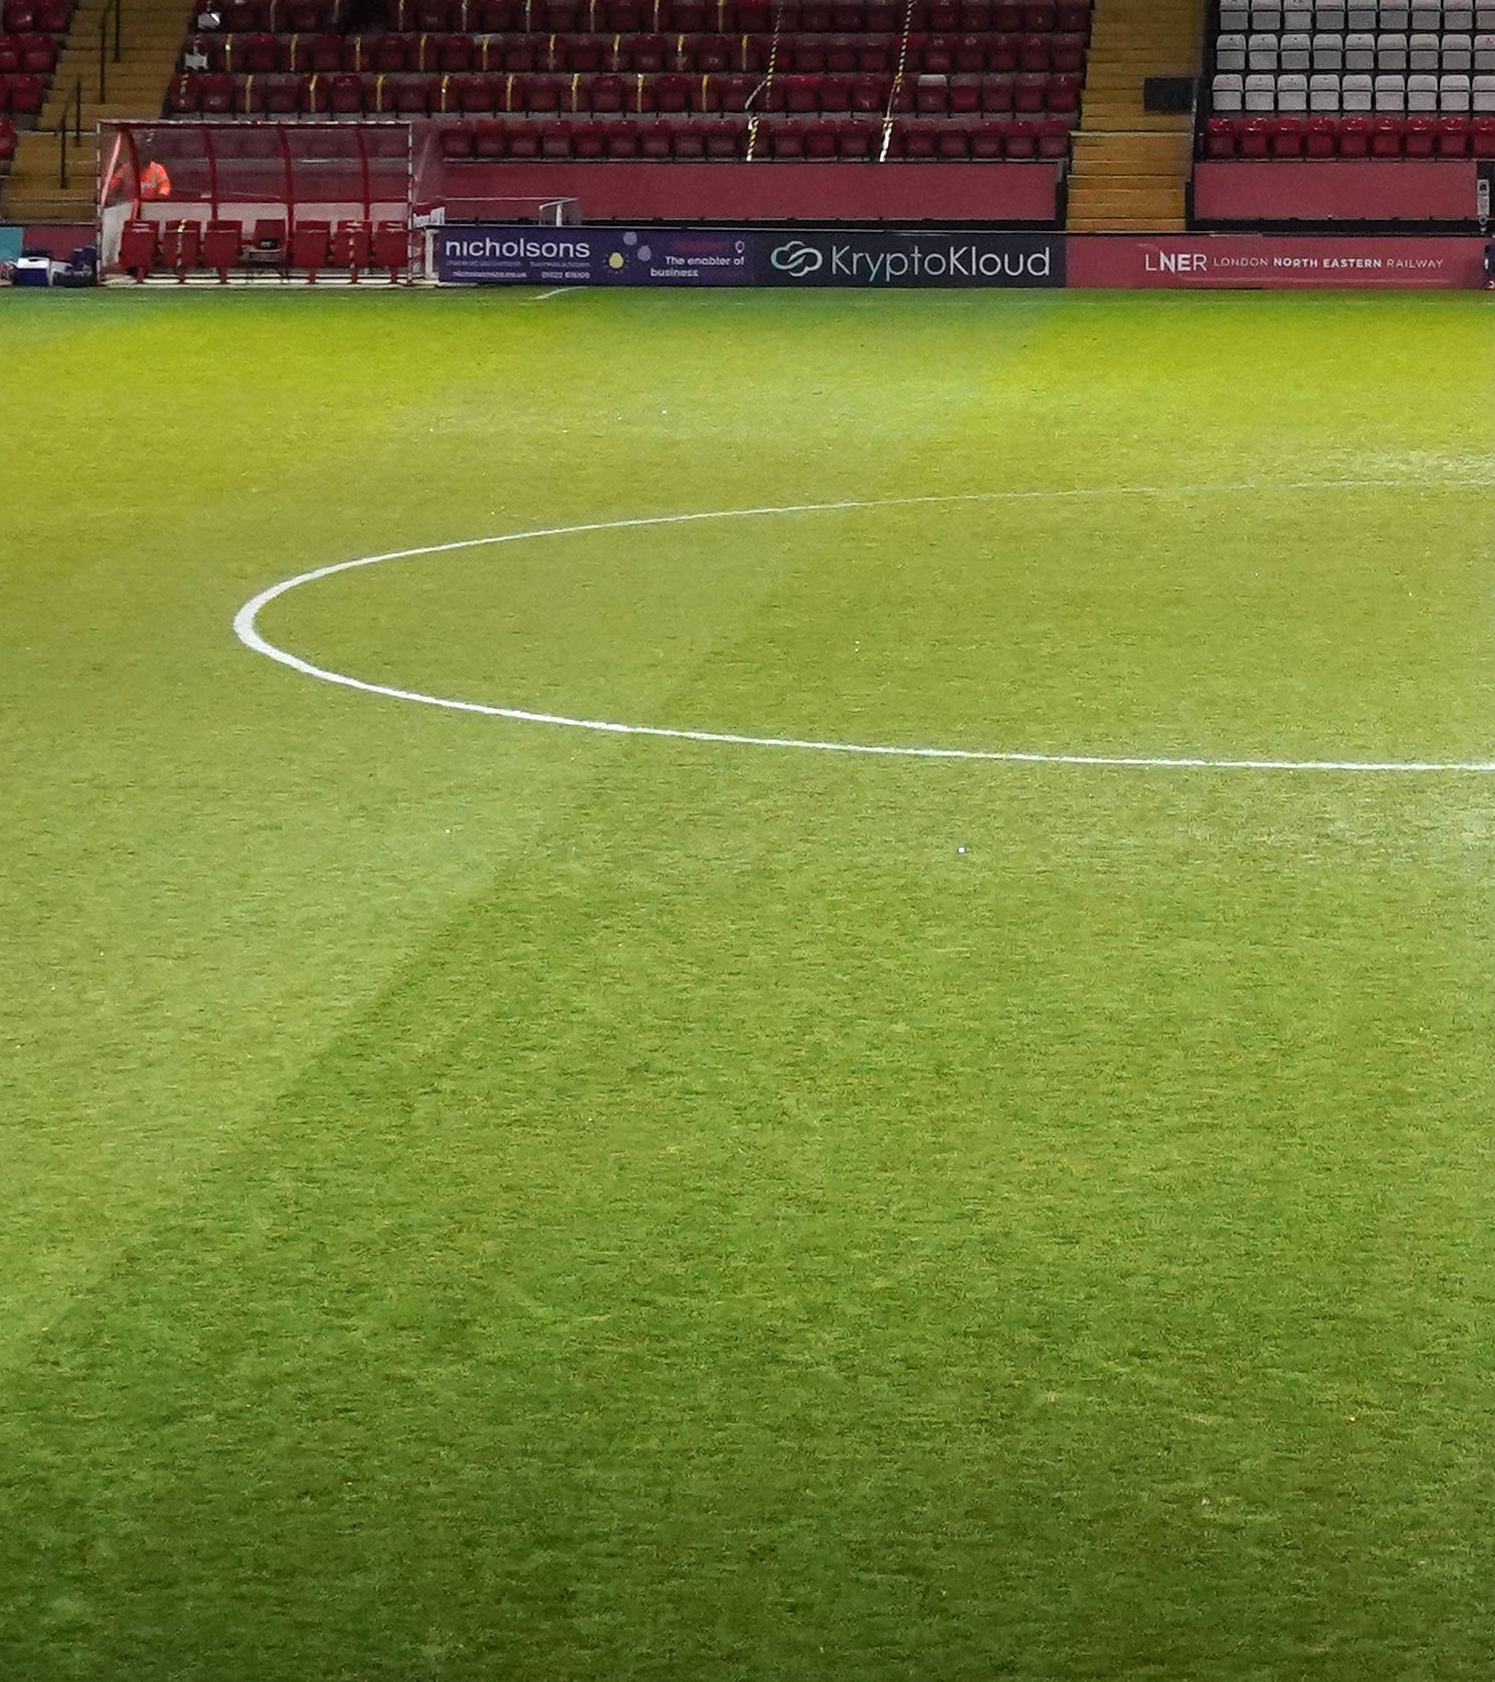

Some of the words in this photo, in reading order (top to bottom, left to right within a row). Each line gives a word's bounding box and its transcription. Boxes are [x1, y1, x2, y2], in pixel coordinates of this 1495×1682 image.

[445, 237, 591, 258] nicholsons
[664, 256, 685, 266] The
[733, 256, 745, 266] of
[831, 245, 1051, 283] KryptoKloud
[1145, 249, 1207, 275] LNER
[1213, 256, 1269, 268] LONDON
[1273, 258, 1319, 268] NORTH
[1323, 258, 1383, 269] EASTERN
[1386, 258, 1444, 269] RAILWAY
